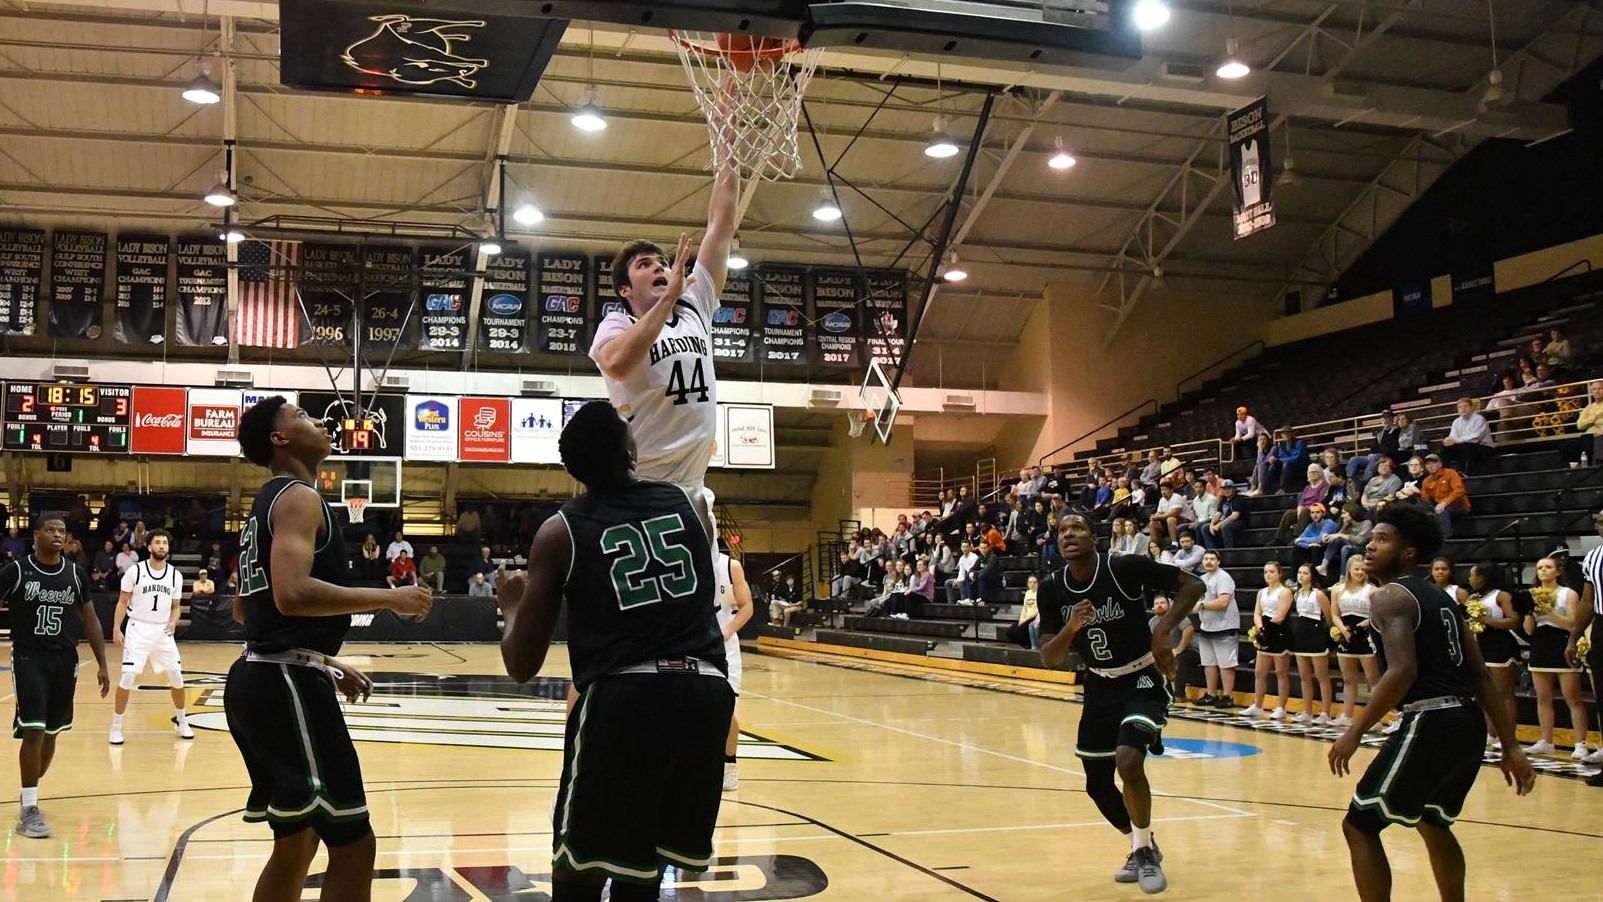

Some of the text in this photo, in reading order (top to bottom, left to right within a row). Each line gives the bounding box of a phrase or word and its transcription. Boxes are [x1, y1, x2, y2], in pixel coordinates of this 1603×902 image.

[1244, 171, 1258, 188] 30
[0, 244, 43, 252] OLLEYBALL
[117, 242, 168, 254] LADY BISON
[178, 244, 228, 255] LADY BISON
[117, 255, 167, 264] VOLLEYBALL
[424, 254, 464, 266] LADY
[544, 258, 583, 270] LADY
[132, 267, 151, 275] GAC
[193, 269, 212, 277] GAC
[118, 276, 165, 284] CHAMPIONS
[542, 272, 584, 284] BISON
[178, 286, 226, 294] CHAMPIONS
[541, 285, 585, 295] BASKETBALL
[816, 286, 854, 298] BISON
[426, 293, 463, 311] GAC
[545, 295, 581, 313] GAC
[313, 303, 341, 316] 24-5
[371, 307, 400, 319] 26-4
[422, 316, 466, 325] CHAMPIONS
[482, 317, 526, 327] TOURNAMENT
[541, 315, 584, 325] CHAMPIONS
[311, 326, 344, 341] 1996
[368, 326, 400, 341] 1997
[428, 326, 460, 336] 29-3
[489, 328, 519, 339] 29-3
[548, 327, 577, 339] 23-7
[711, 327, 750, 337] CHAMPIONS
[764, 327, 803, 337] TOURNAMENT
[429, 338, 460, 348] 2014
[489, 340, 519, 350] 2014
[548, 341, 577, 352] 2015
[713, 337, 746, 348] 31-4
[763, 337, 804, 347] CHAMPIONS
[821, 342, 852, 352] CHAMPIONS
[867, 338, 886, 346] FINAL
[650, 336, 708, 366] HARDING
[713, 349, 746, 359] 2017
[767, 351, 800, 361] 2017
[823, 353, 850, 363] 2017
[665, 358, 709, 405] 44
[10, 385, 33, 394] HOME
[100, 388, 129, 398] VISITOR
[47, 387, 95, 405] 18:15
[22, 395, 34, 413] 2
[115, 398, 127, 415] 3
[51, 411, 72, 419] PERIOD
[78, 409, 83, 423] 1
[205, 408, 235, 419] FARM
[97, 416, 115, 424] BONUS
[193, 418, 235, 429] BUREAU
[345, 419, 374, 431] 18:15
[7, 423, 25, 431] FOULS
[19, 430, 24, 444] 1
[33, 434, 41, 443] 4
[121, 432, 126, 446] 1
[200, 429, 235, 438] INSURANCE
[464, 430, 504, 438] COUSINS
[91, 435, 99, 446] 4
[352, 430, 369, 449] 19
[599, 512, 698, 611] 25
[142, 584, 171, 597] HARDING
[151, 594, 158, 612] 1
[34, 605, 64, 637] 15
[1439, 607, 1464, 668] 3
[1087, 628, 1113, 661] 2
